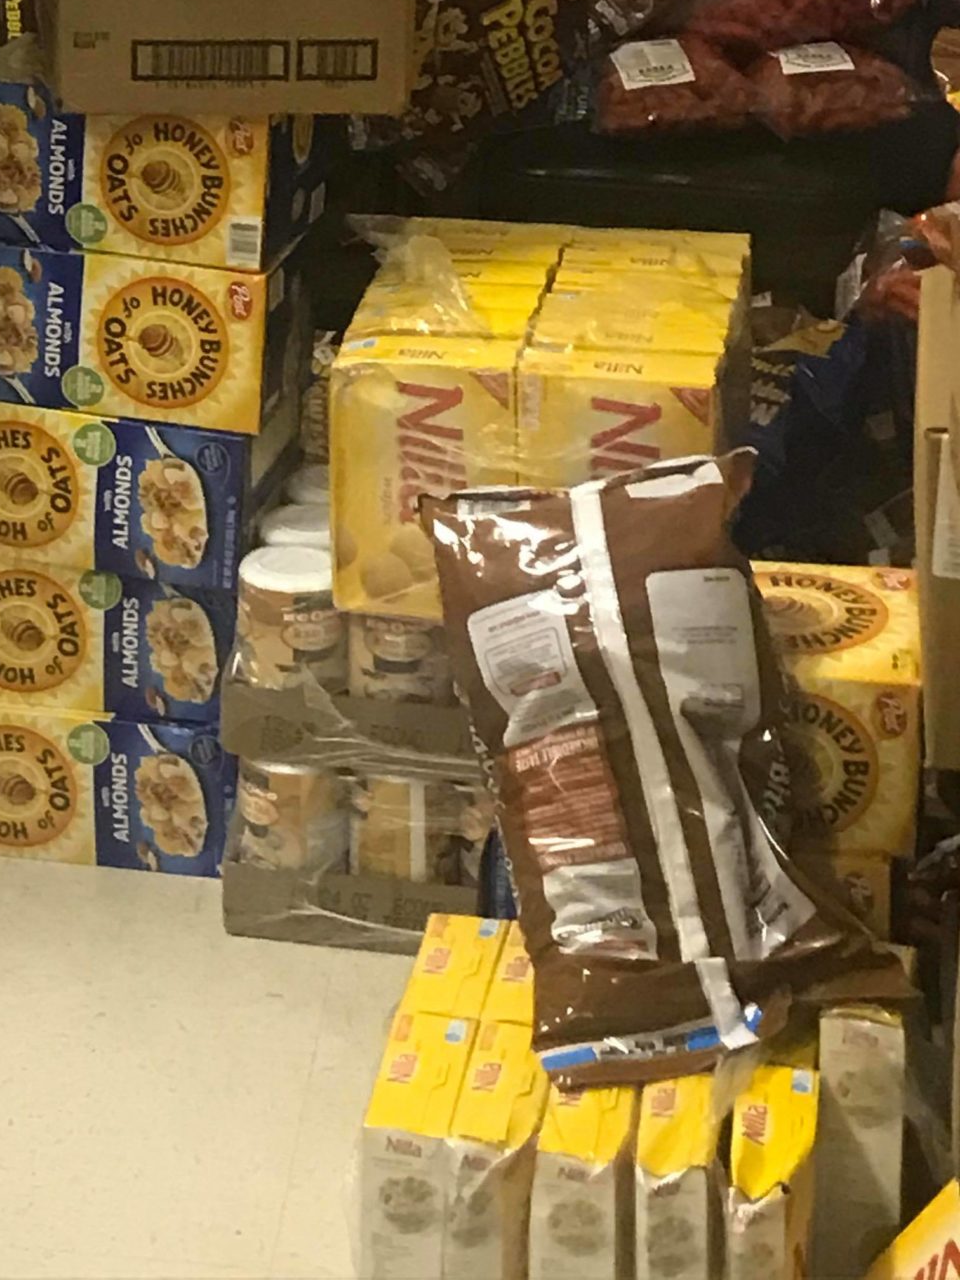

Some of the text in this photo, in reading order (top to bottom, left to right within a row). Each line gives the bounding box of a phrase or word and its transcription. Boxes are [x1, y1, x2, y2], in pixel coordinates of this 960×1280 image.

[48, 119, 68, 215] ALMONDS
[153, 122, 220, 170] HONEY
[107, 153, 139, 222] OATS
[149, 174, 223, 238] BUNCHES
[44, 282, 64, 378] ALMONDS
[151, 286, 218, 334] HONEY
[104, 317, 138, 384] OATS
[146, 339, 222, 400] BUNCHES
[41, 446, 72, 514] OATS
[112, 455, 133, 550] ALMONDS
[769, 575, 867, 606] HONEY
[46, 593, 80, 657] OATS
[121, 597, 140, 688] ALMONDS
[36, 748, 71, 812] OATS
[112, 752, 128, 843] ALMONDS
